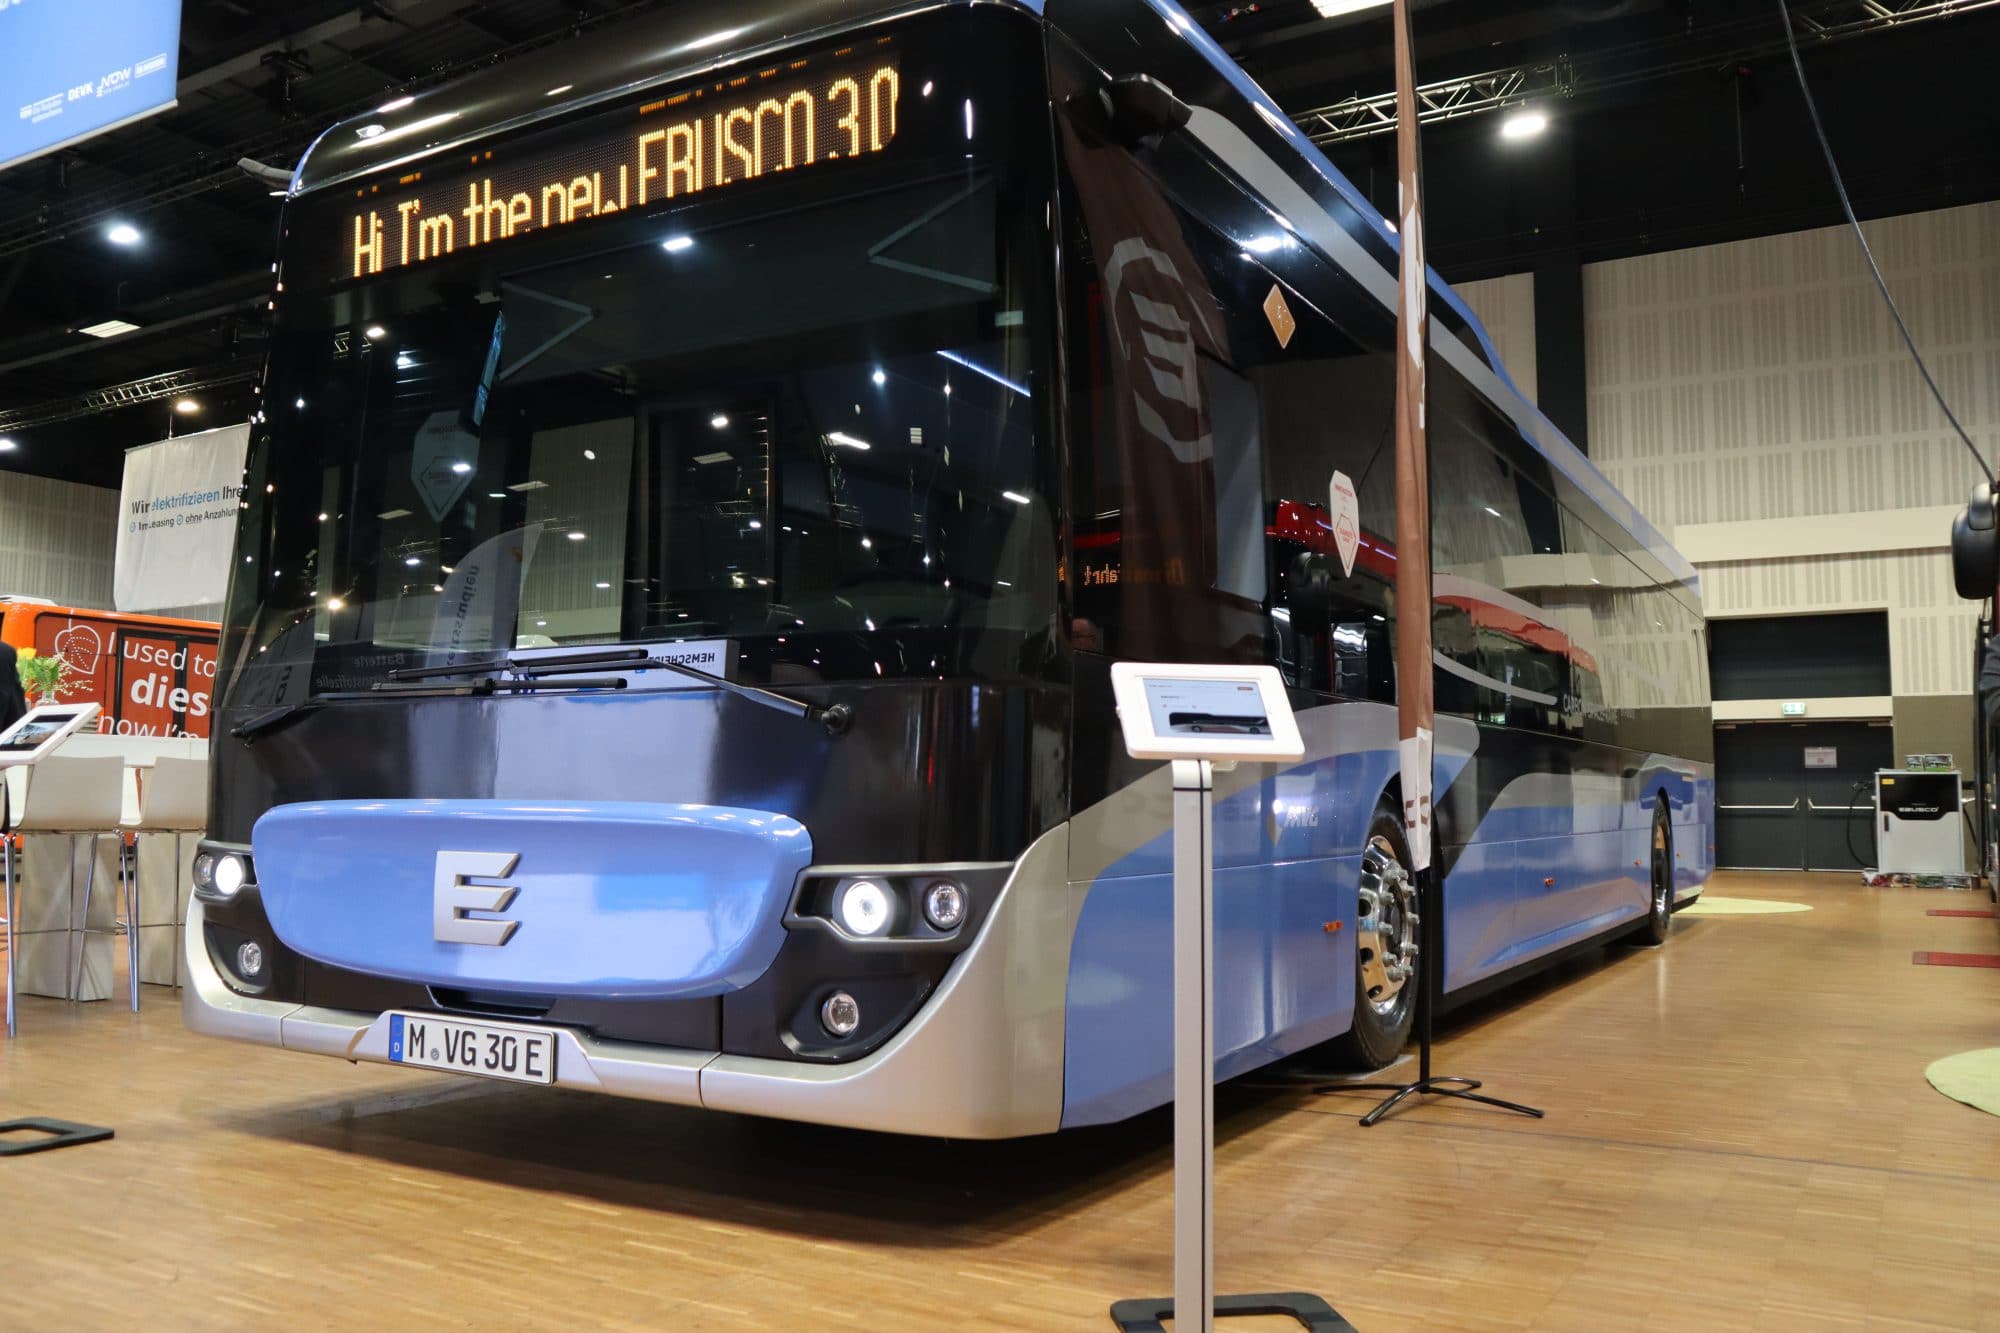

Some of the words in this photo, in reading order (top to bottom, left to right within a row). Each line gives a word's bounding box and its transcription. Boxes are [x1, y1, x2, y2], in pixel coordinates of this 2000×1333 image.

[67, 82, 94, 101] DEVK
[353, 210, 384, 277] Hi
[462, 177, 533, 247] the
[541, 164, 629, 228] new
[132, 500, 151, 515] Wir
[151, 490, 220, 511] elektrifizieren
[222, 486, 242, 500] Ihre
[185, 513, 203, 523] ohne
[108, 631, 116, 654] I
[123, 640, 188, 671] used
[194, 654, 217, 678] to
[130, 672, 210, 717] dies
[97, 715, 157, 737] now
[408, 1023, 425, 1059] M
[444, 1028, 477, 1067] VG
